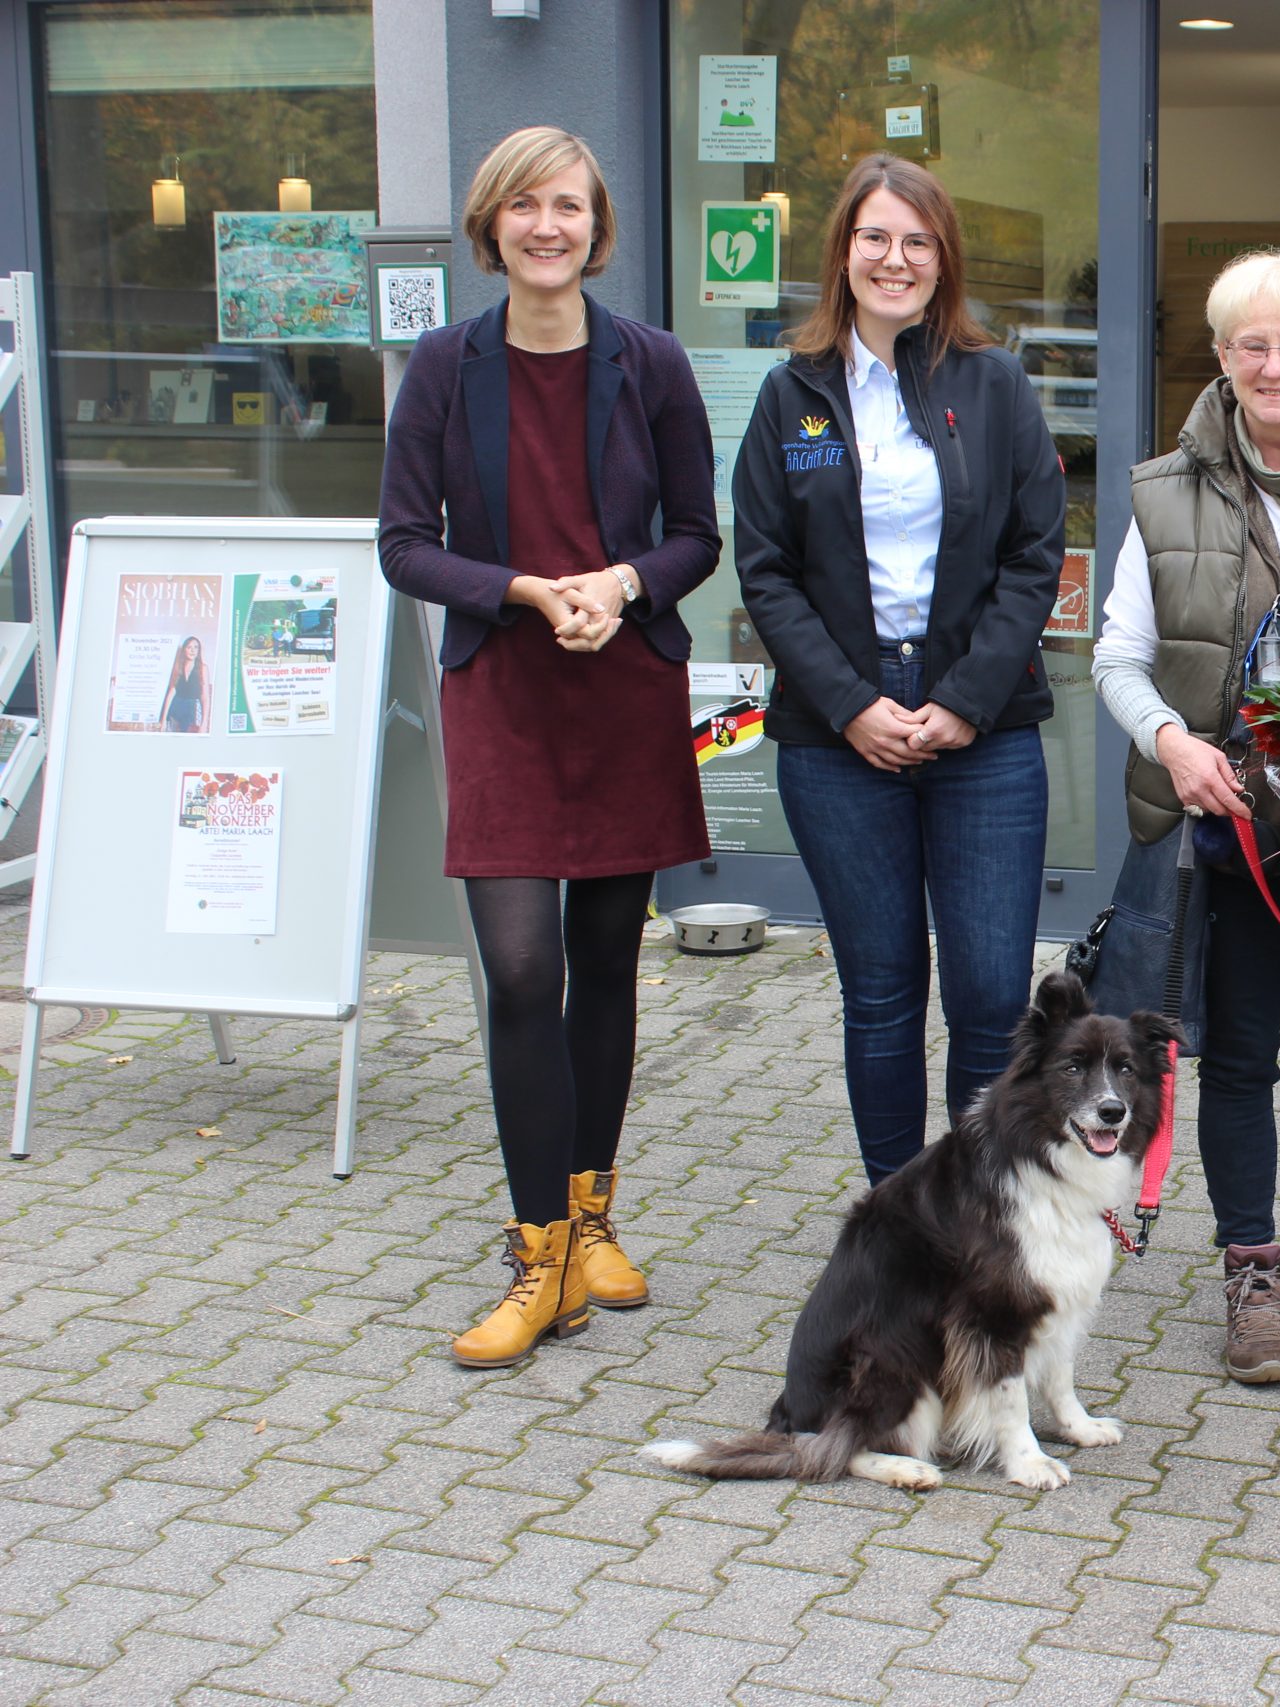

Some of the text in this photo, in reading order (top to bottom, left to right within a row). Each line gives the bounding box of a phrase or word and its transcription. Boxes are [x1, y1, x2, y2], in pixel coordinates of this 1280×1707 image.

[824, 447, 846, 466] SEE
[122, 582, 216, 600] SIOBHAN
[121, 600, 214, 618] MILLER
[262, 669, 289, 677] bringen
[304, 666, 331, 674] weiter!
[228, 793, 251, 804] DAS
[208, 805, 275, 816] NOVEMBER
[212, 816, 270, 826] KONZERT
